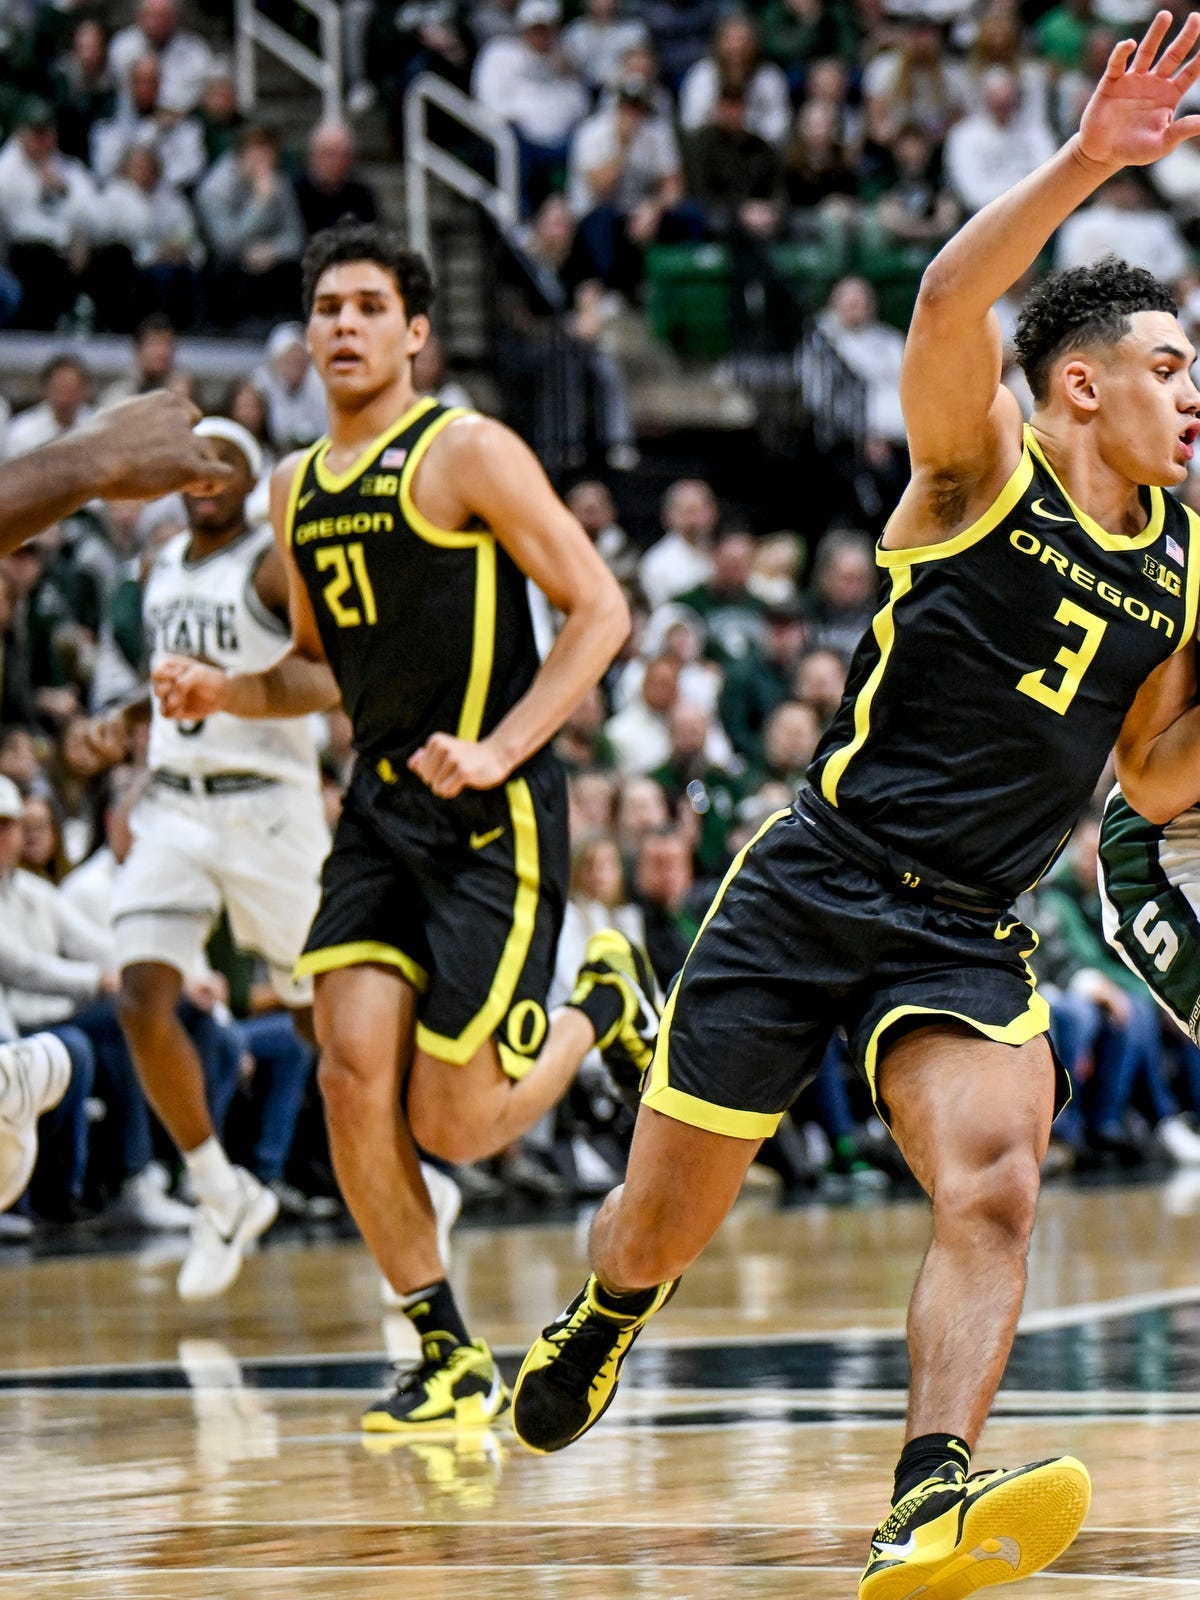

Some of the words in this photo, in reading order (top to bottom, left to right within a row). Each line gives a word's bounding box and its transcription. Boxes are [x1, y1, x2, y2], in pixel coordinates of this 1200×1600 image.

[295, 512, 394, 545] OREGON
[314, 542, 378, 628] 21
[1009, 529, 1175, 639] OREGON
[1015, 597, 1108, 716] 3
[1132, 901, 1179, 972] S
